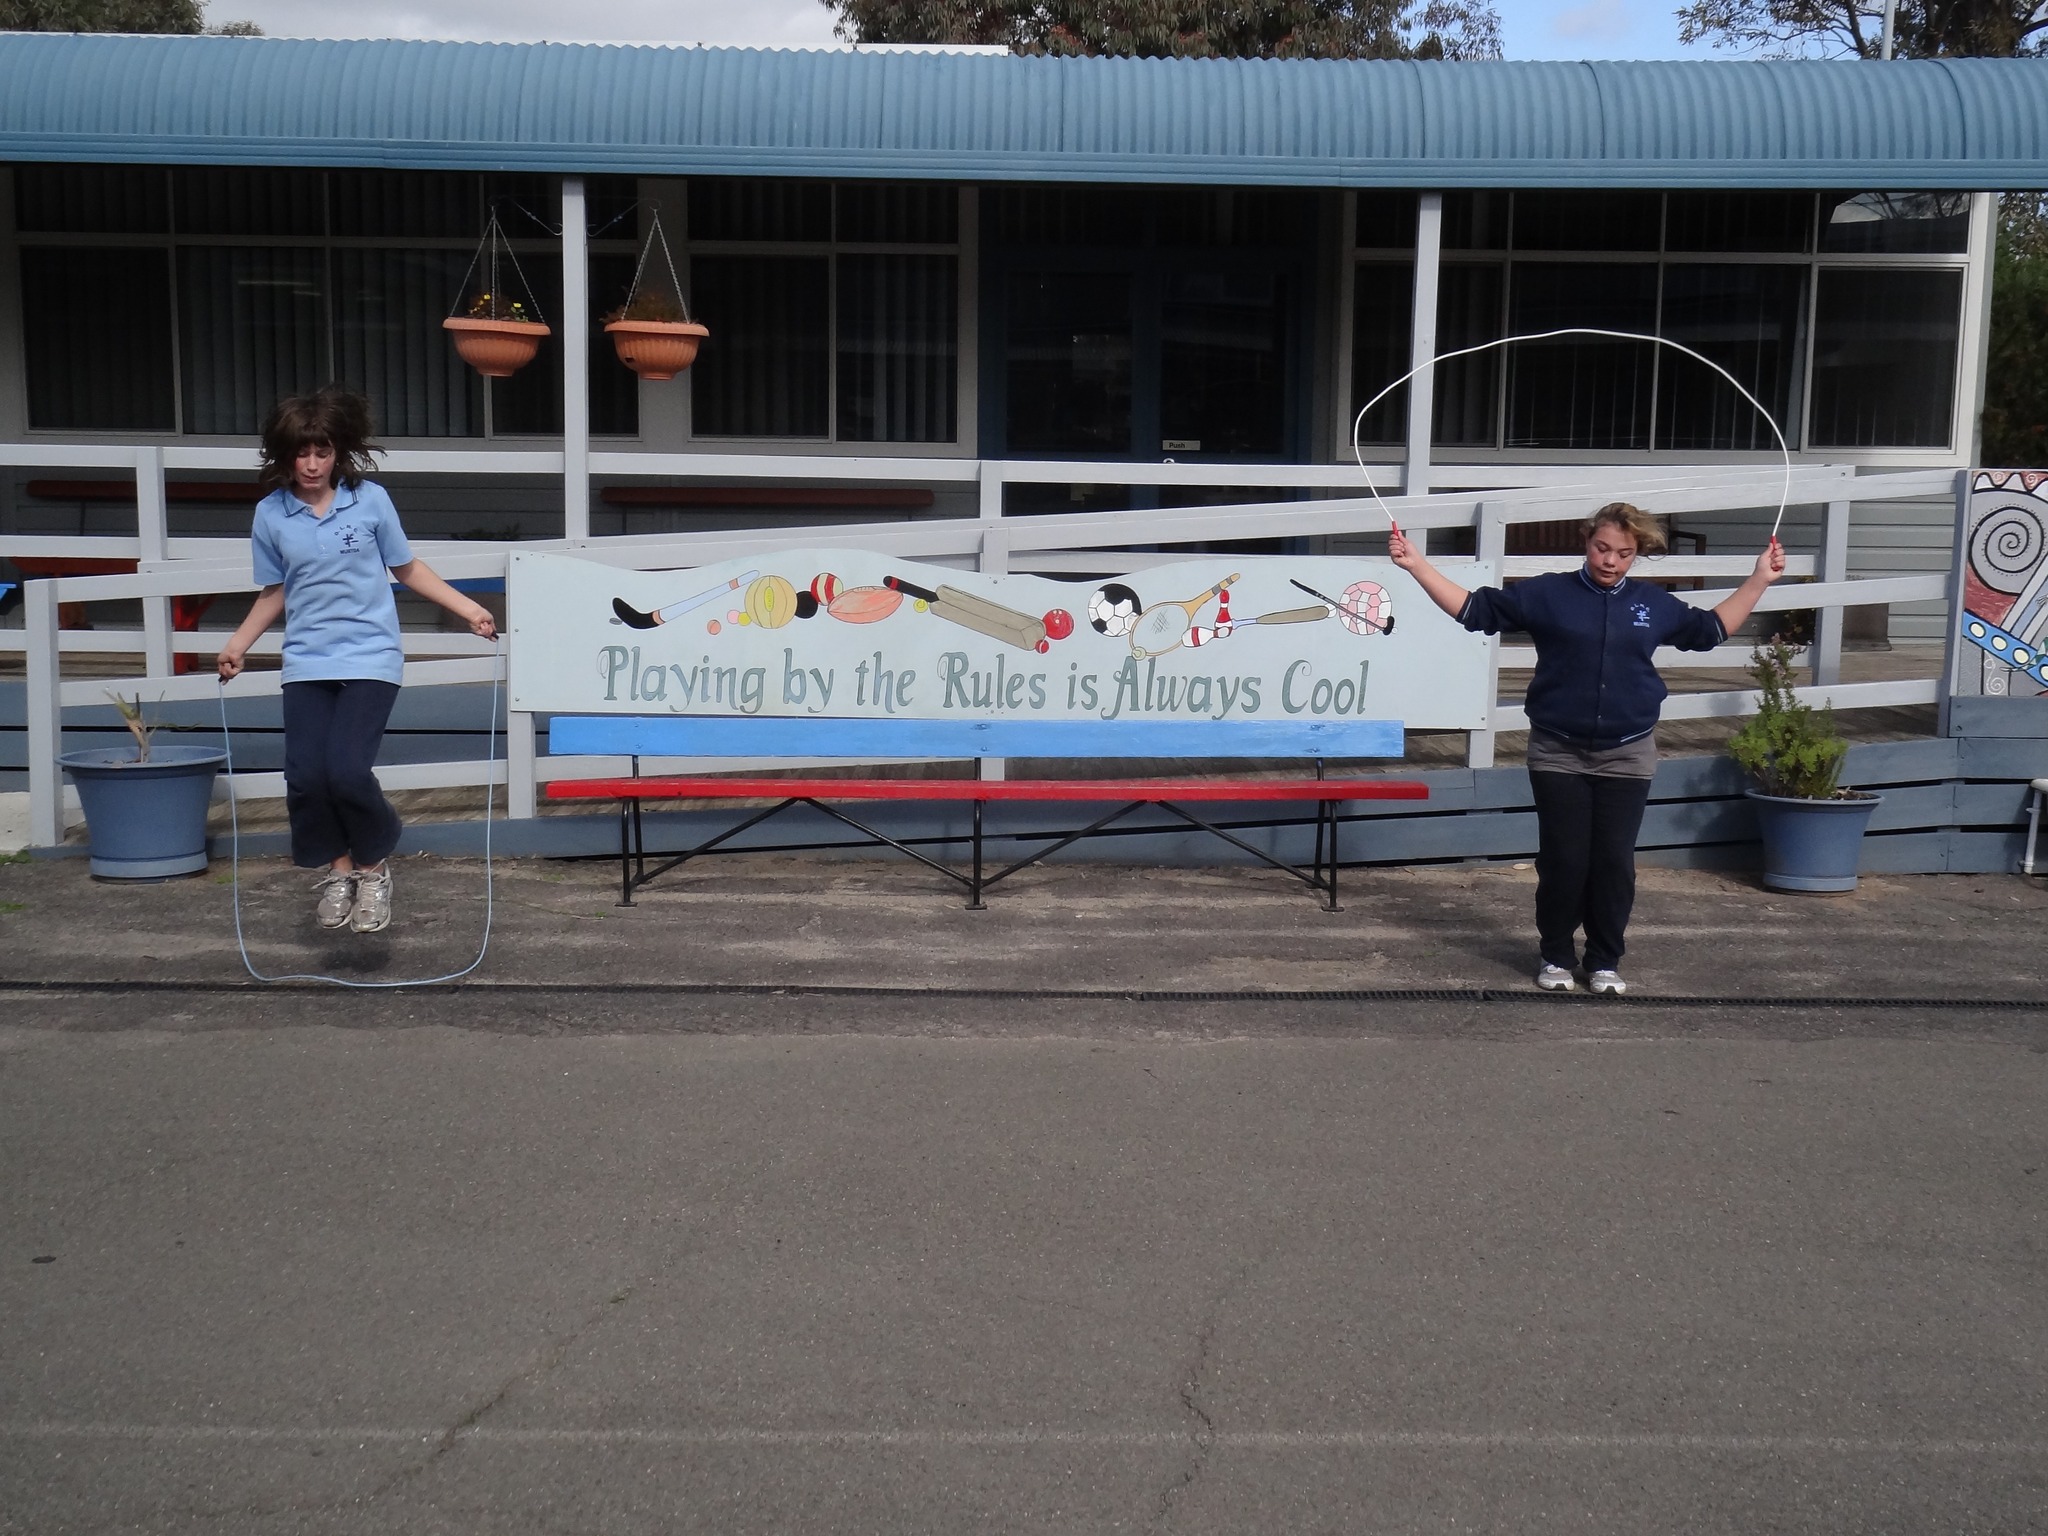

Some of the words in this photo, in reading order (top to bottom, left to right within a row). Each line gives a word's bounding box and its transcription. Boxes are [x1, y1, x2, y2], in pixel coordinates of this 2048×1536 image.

[596, 645, 767, 714] Playing
[782, 648, 835, 714] by
[855, 651, 916, 714] the
[937, 651, 1047, 709] Rules
[1067, 662, 1099, 710] is
[1100, 655, 1262, 720] Always
[1281, 659, 1370, 715] Cool
